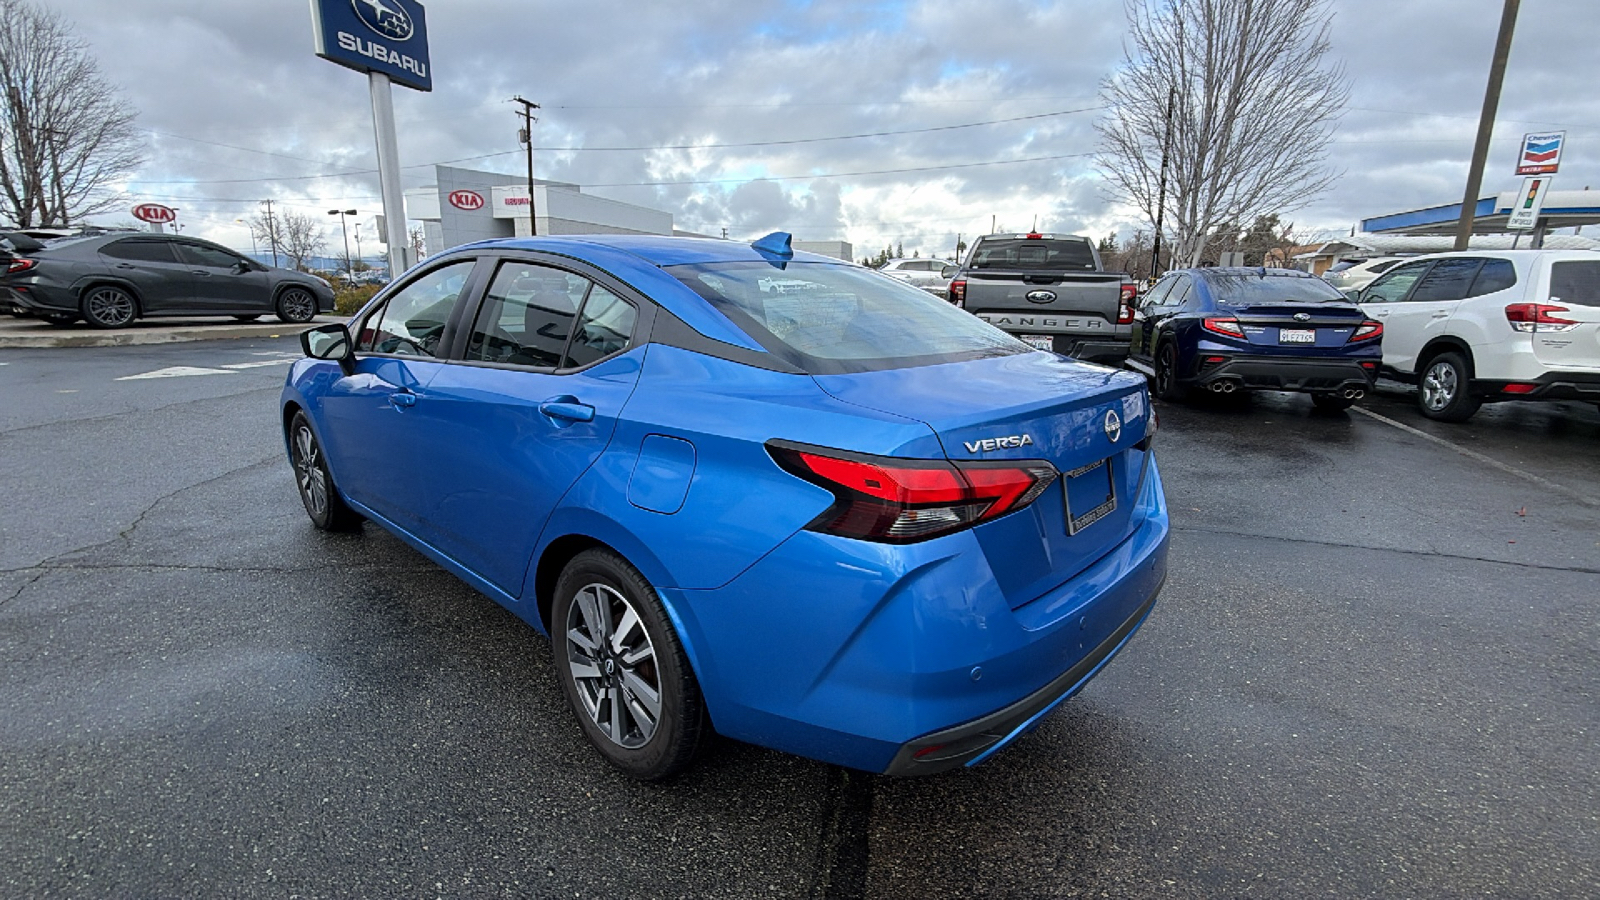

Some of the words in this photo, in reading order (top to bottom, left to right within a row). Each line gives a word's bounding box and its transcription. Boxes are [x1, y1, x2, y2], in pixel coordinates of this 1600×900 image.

[337, 31, 426, 78] SUBARU
[454, 193, 480, 207] KIA
[142, 207, 171, 220] KIA
[963, 434, 1034, 453] VERSA
